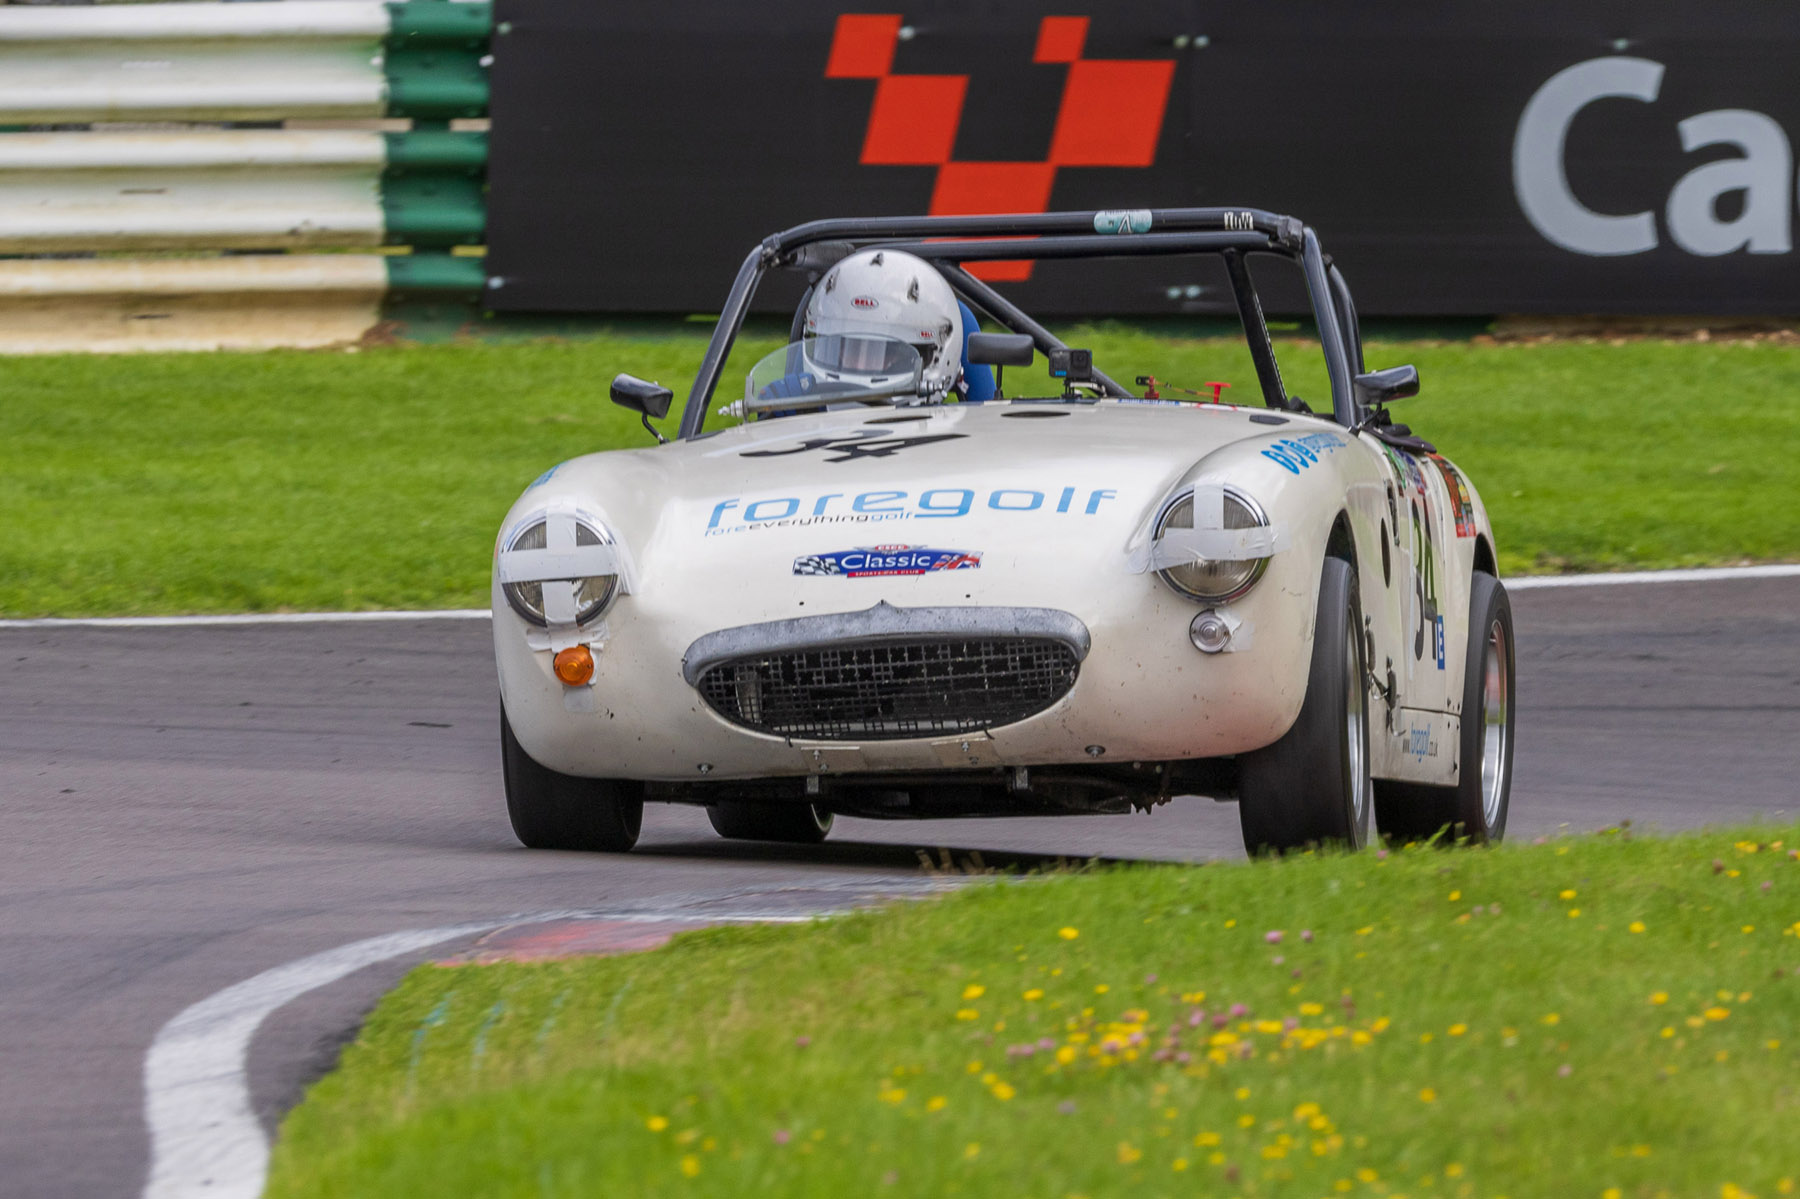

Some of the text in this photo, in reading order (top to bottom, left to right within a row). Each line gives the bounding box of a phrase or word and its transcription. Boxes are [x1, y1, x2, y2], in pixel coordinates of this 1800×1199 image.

[1511, 55, 1800, 257] Ca
[854, 298, 875, 307] BELL
[707, 486, 1118, 529] foregolf
[840, 553, 931, 570] Classic
